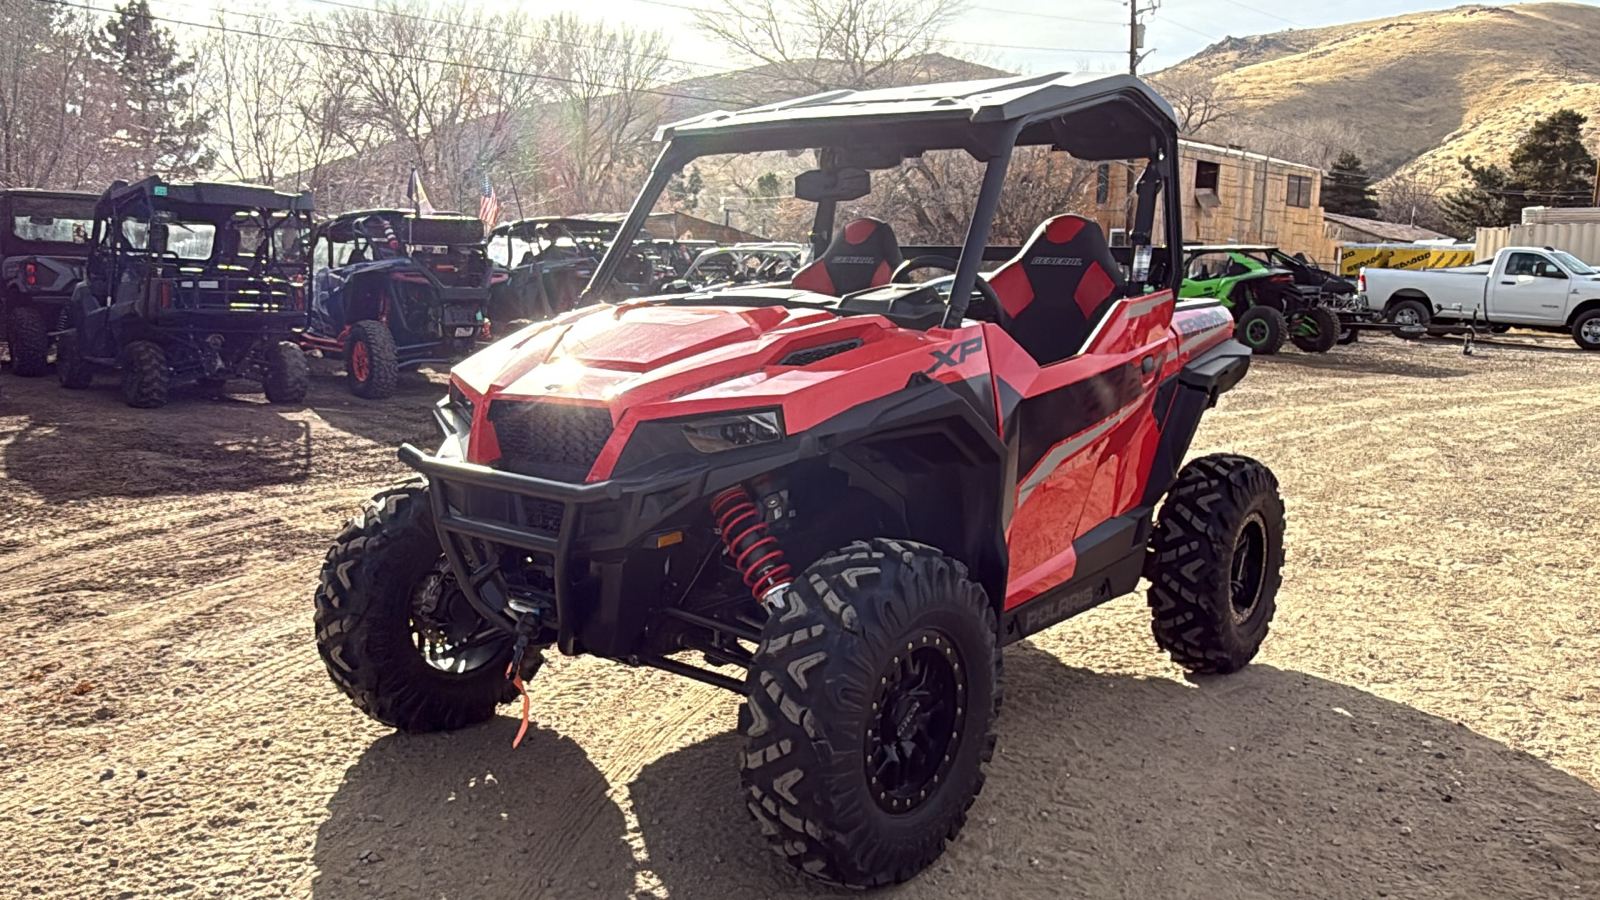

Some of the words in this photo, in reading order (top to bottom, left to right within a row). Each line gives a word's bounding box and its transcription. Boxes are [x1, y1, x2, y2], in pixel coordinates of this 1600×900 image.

[831, 256, 875, 264] GENERAL
[1031, 256, 1082, 266] GENERAL
[924, 335, 983, 374] XP
[1026, 587, 1092, 629] POLARIS
